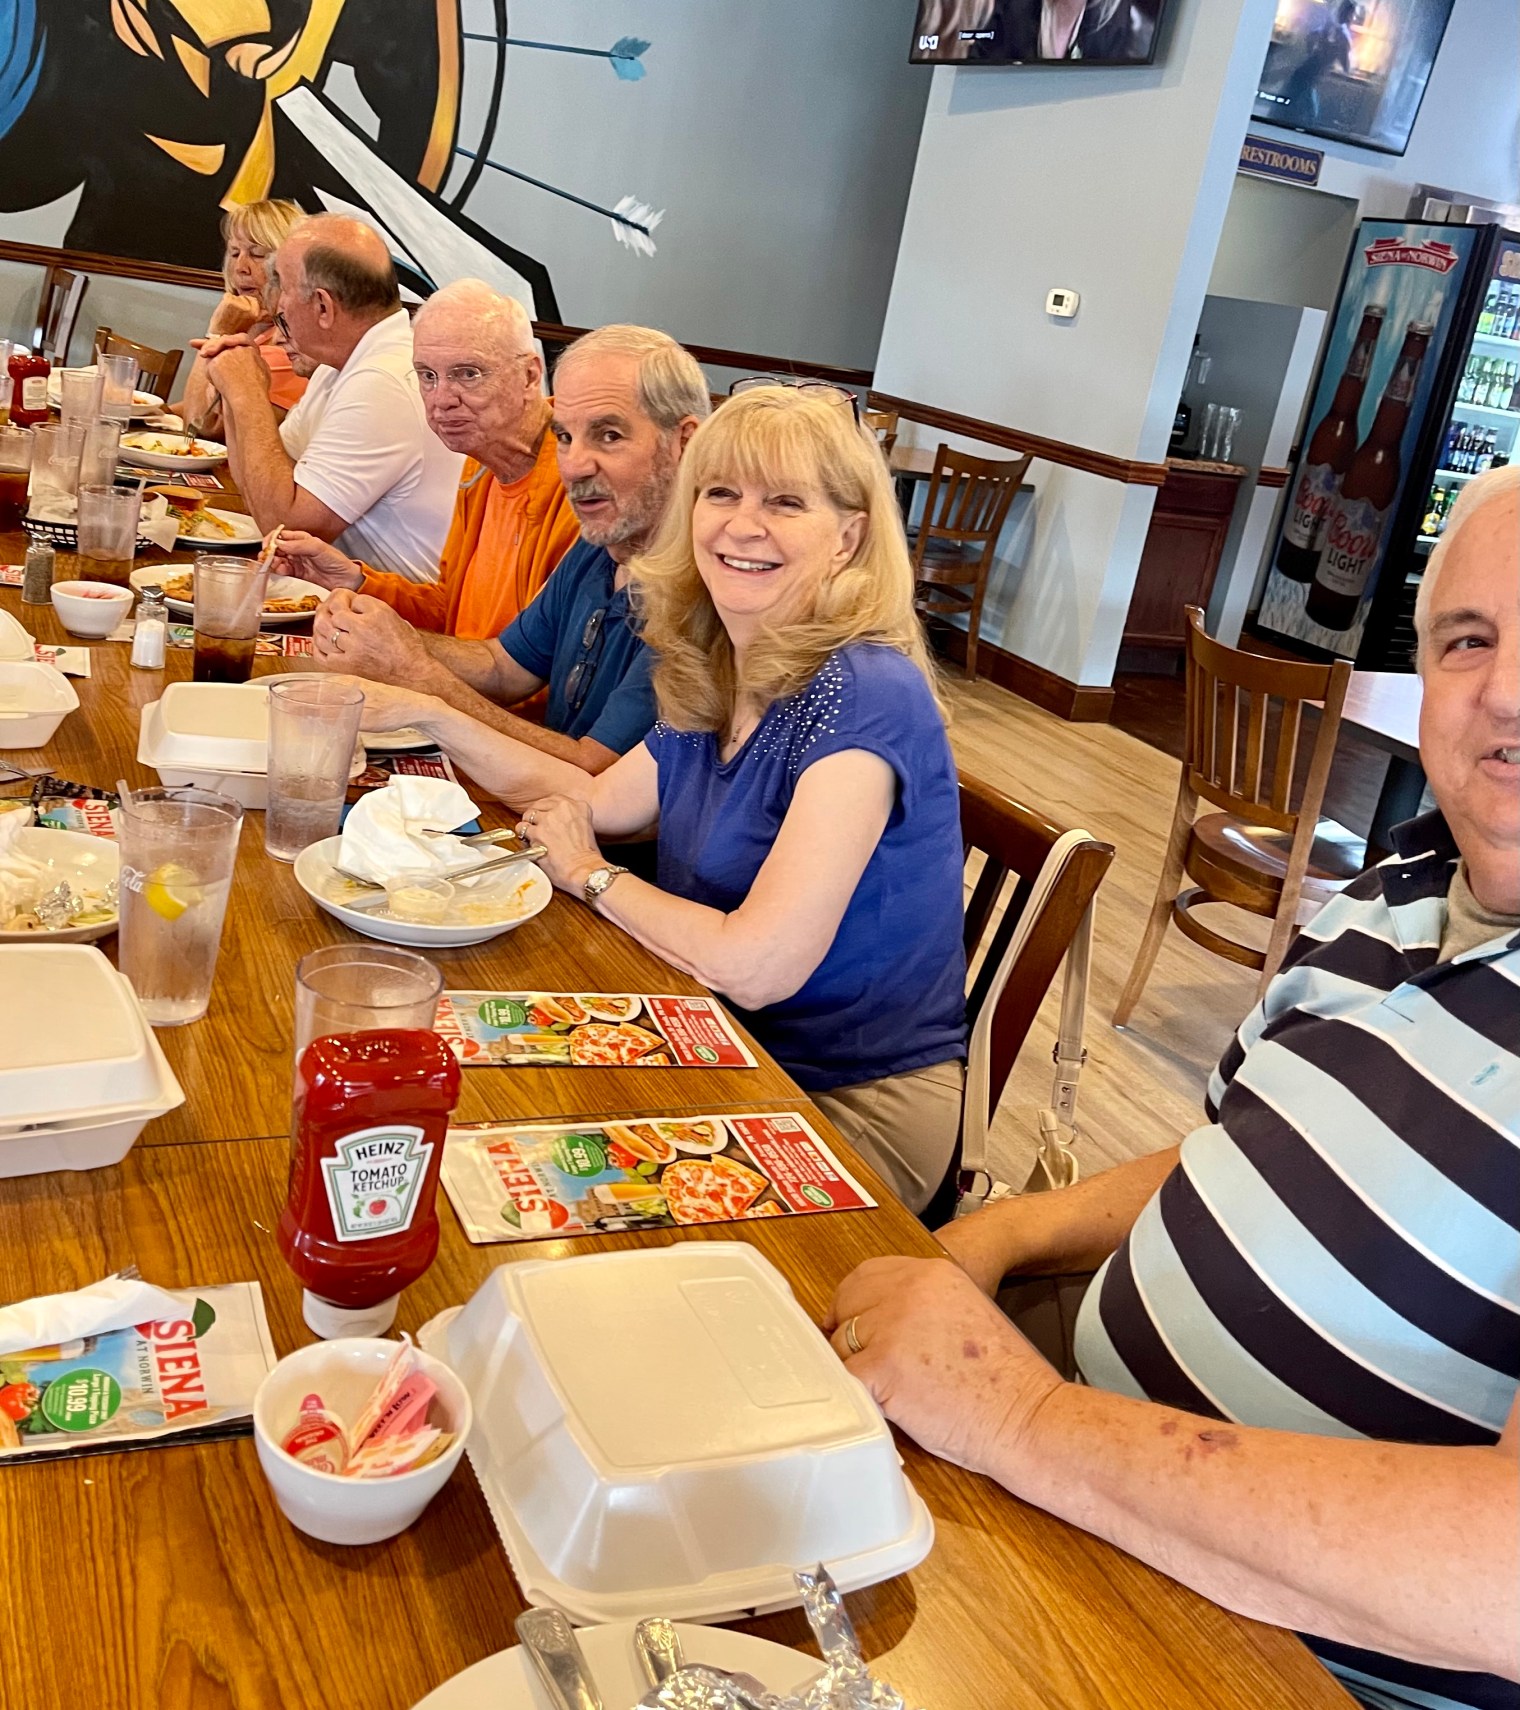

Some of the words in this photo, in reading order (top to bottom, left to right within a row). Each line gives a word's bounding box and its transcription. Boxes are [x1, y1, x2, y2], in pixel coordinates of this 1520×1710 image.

[1241, 144, 1317, 176] RESTROOMS
[1327, 548, 1367, 576] LIGHT
[355, 1142, 405, 1160] HEINZ
[350, 1163, 407, 1183] TOMATO
[353, 1176, 405, 1193] KETCHUP
[487, 1142, 550, 1213] SIENA
[136, 1340, 149, 1354] AT
[138, 1354, 154, 1394] NORWIN
[153, 1319, 208, 1421] SIENA
[66, 1379, 89, 1411] $10.99
